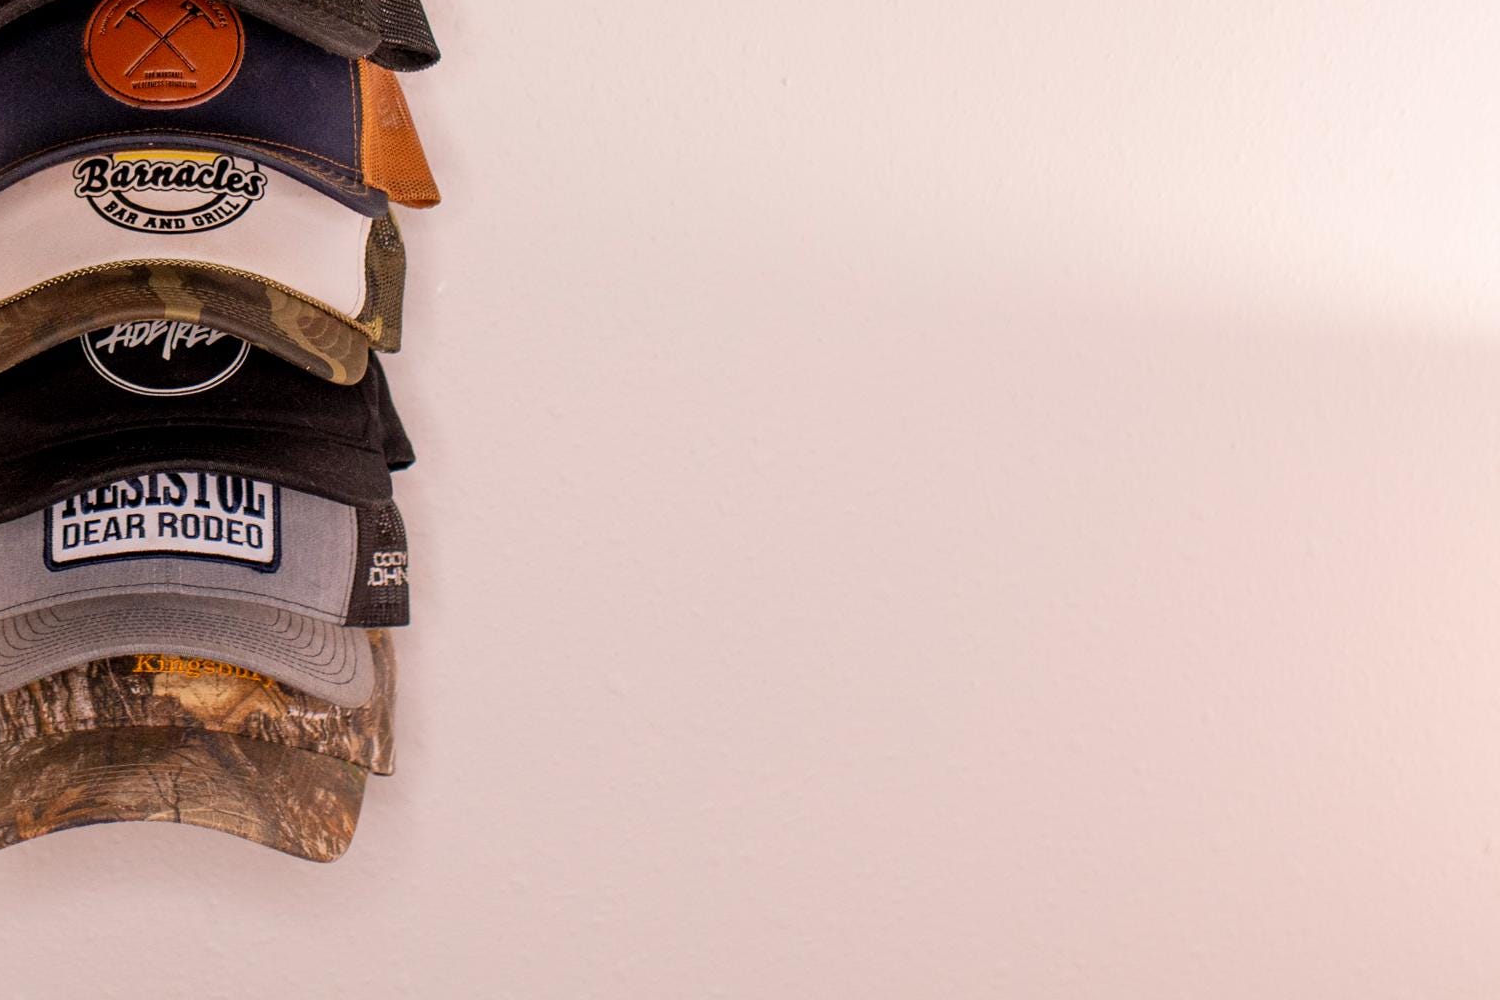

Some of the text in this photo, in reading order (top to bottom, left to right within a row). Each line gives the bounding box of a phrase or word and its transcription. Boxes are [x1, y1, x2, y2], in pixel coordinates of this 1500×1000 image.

[75, 156, 266, 198] Barnacles
[103, 200, 241, 229] BAR AND GRILL
[62, 511, 264, 550] DEAR RODEO
[132, 653, 277, 690] Kingsbu
